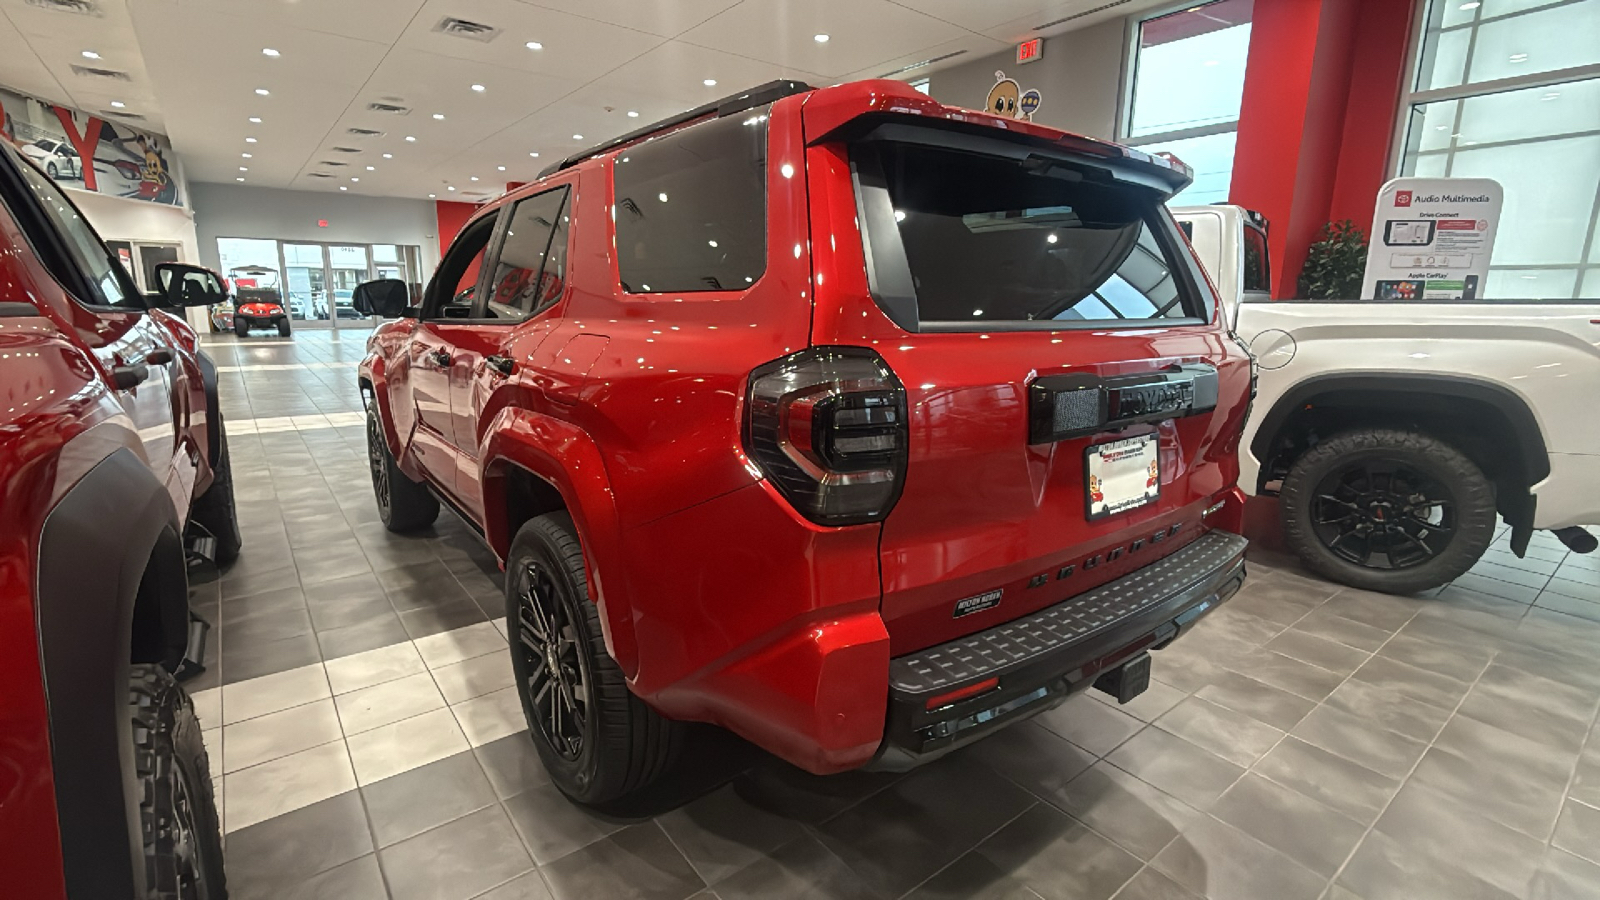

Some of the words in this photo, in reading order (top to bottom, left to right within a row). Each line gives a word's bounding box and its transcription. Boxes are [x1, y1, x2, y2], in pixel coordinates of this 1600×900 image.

[1019, 39, 1037, 60] EXIT
[1414, 194, 1440, 203] Audio
[1441, 194, 1490, 203] Multimedia
